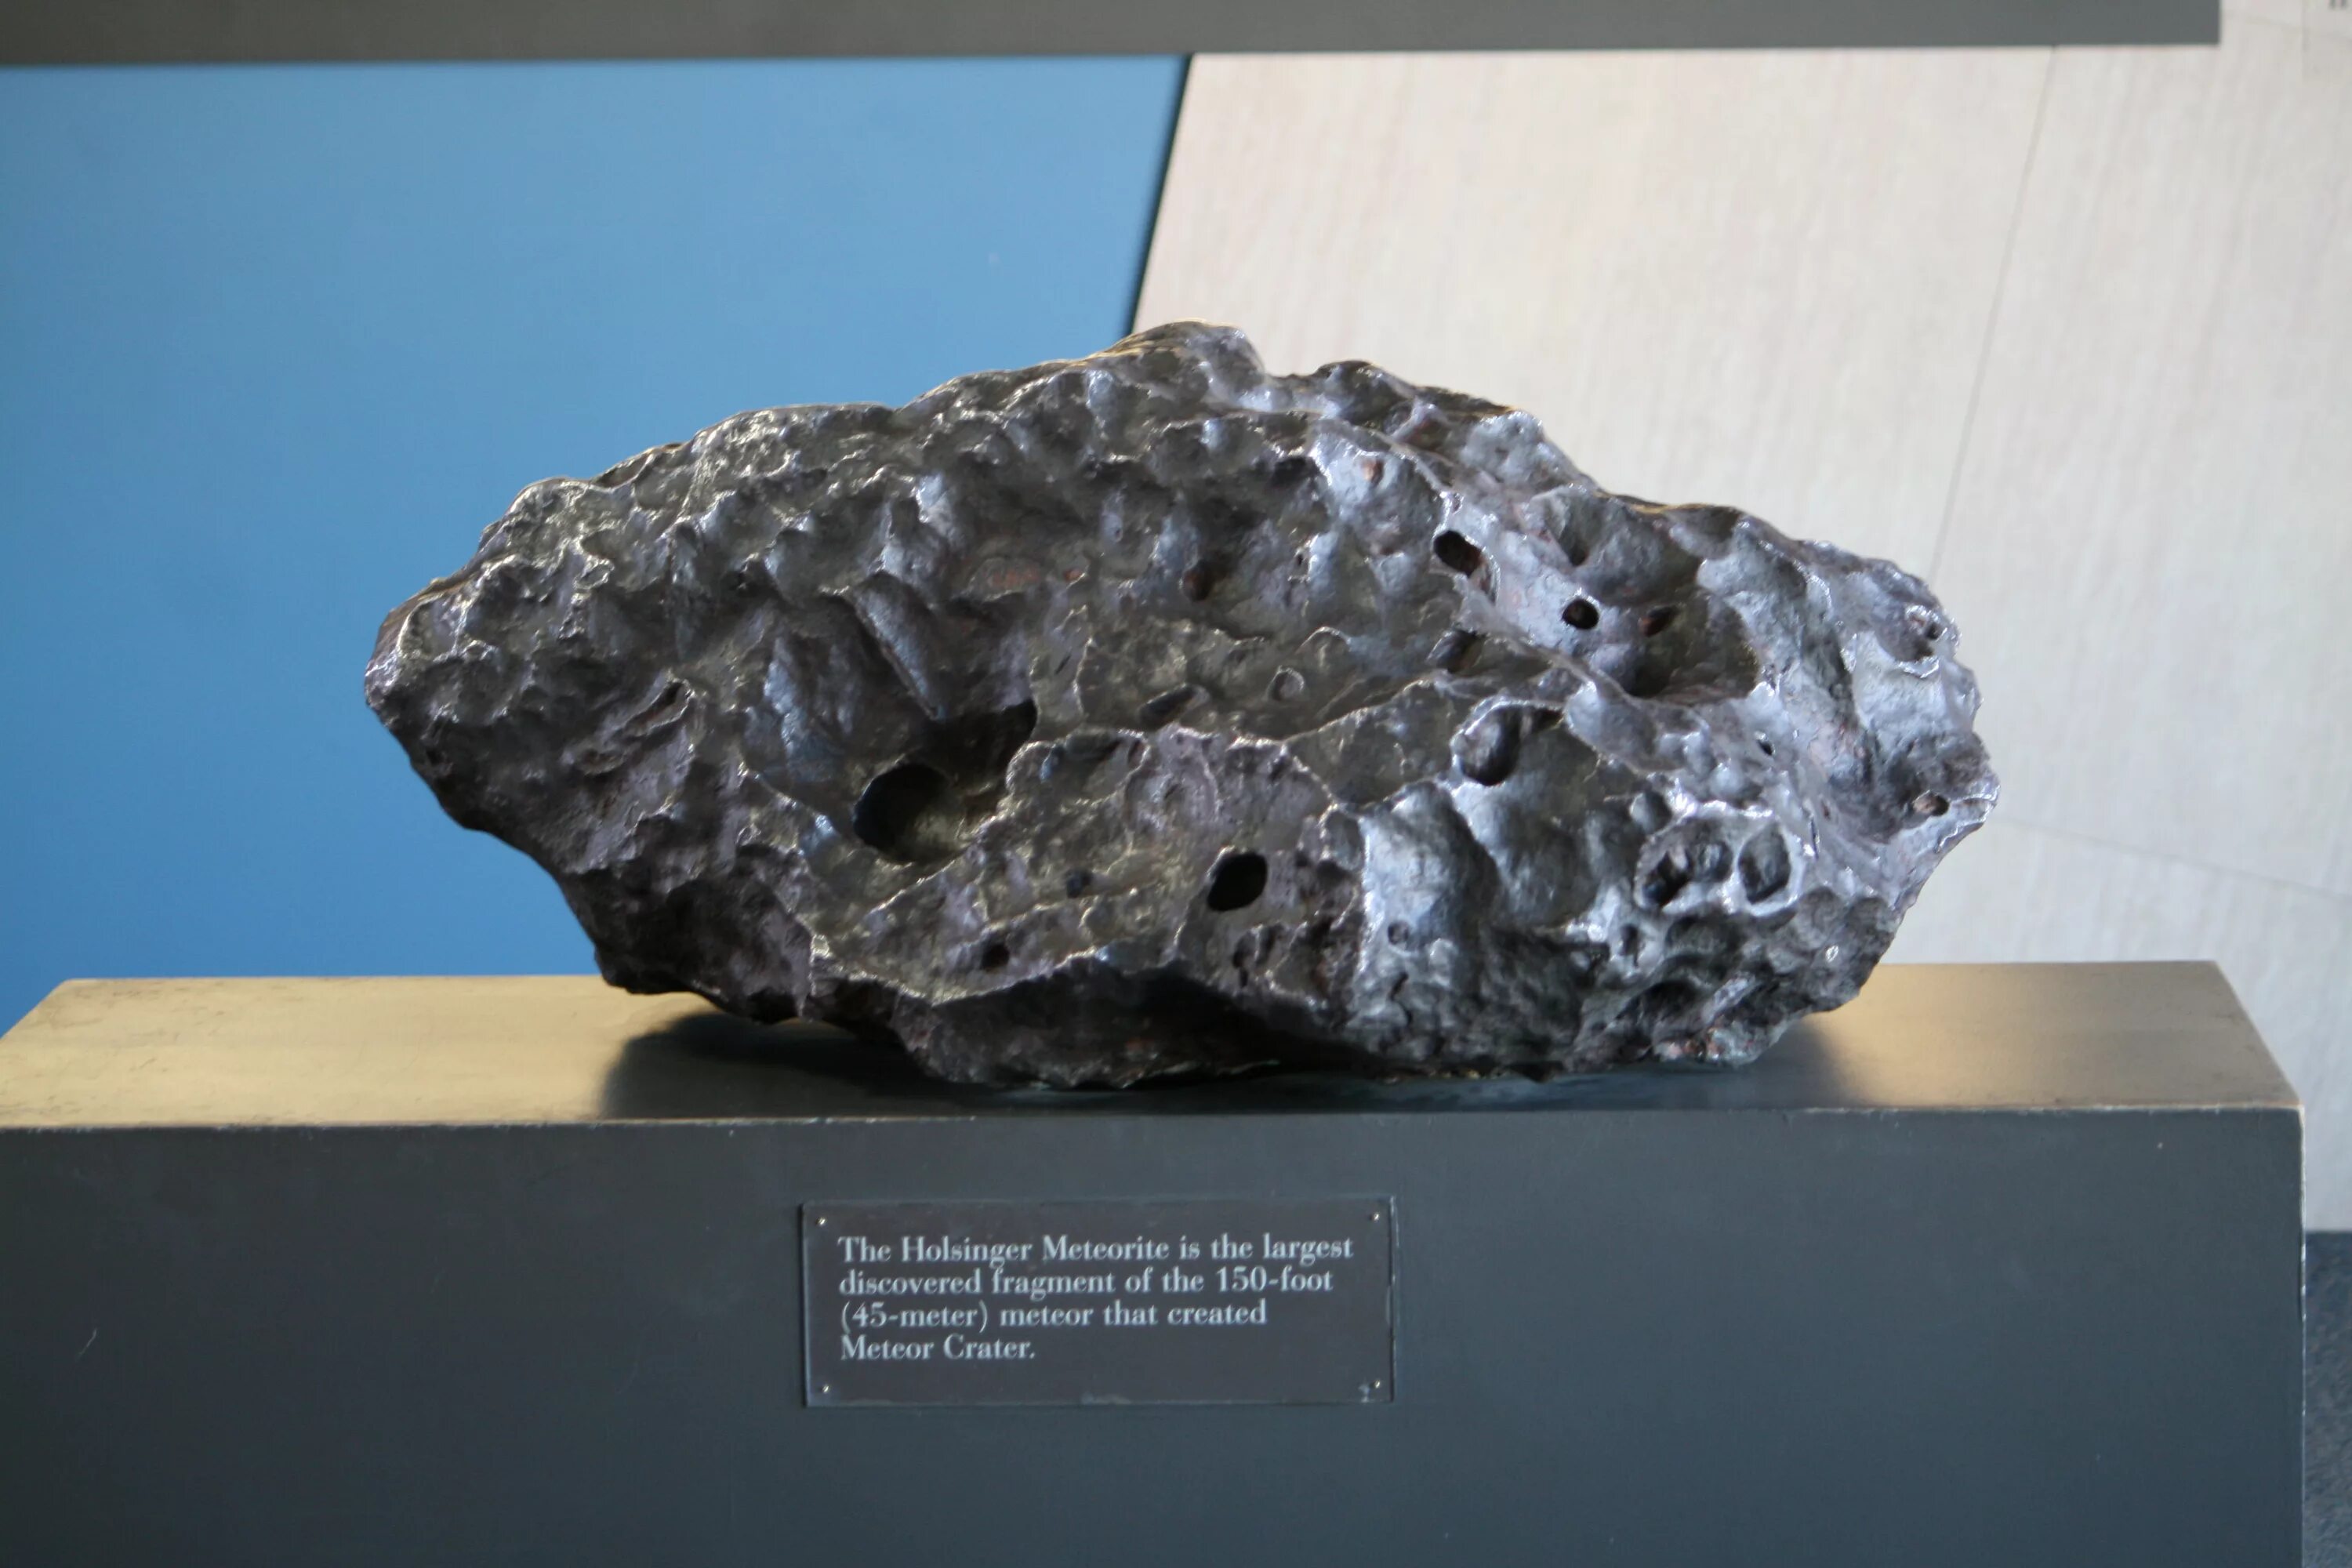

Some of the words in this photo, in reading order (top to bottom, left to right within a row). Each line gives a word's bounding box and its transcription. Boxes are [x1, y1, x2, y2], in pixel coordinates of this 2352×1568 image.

[837, 1236, 891, 1262] The
[902, 1235, 1033, 1269] Holsinger
[1042, 1234, 1170, 1261] Meteorite
[1179, 1235, 1201, 1260] is
[1210, 1232, 1254, 1260] the
[1262, 1232, 1354, 1267] largest
[839, 1267, 982, 1295] discovered
[989, 1265, 1116, 1300] fragment
[1124, 1266, 1154, 1293] of
[1162, 1265, 1204, 1293] the
[1216, 1263, 1334, 1292] 150-foot
[841, 1300, 988, 1334] (45-meter)
[1000, 1306, 1094, 1327] meteor
[1103, 1299, 1158, 1326] that
[1167, 1298, 1267, 1325] created
[841, 1332, 935, 1360] Meteor
[943, 1334, 1036, 1359] Crater.
